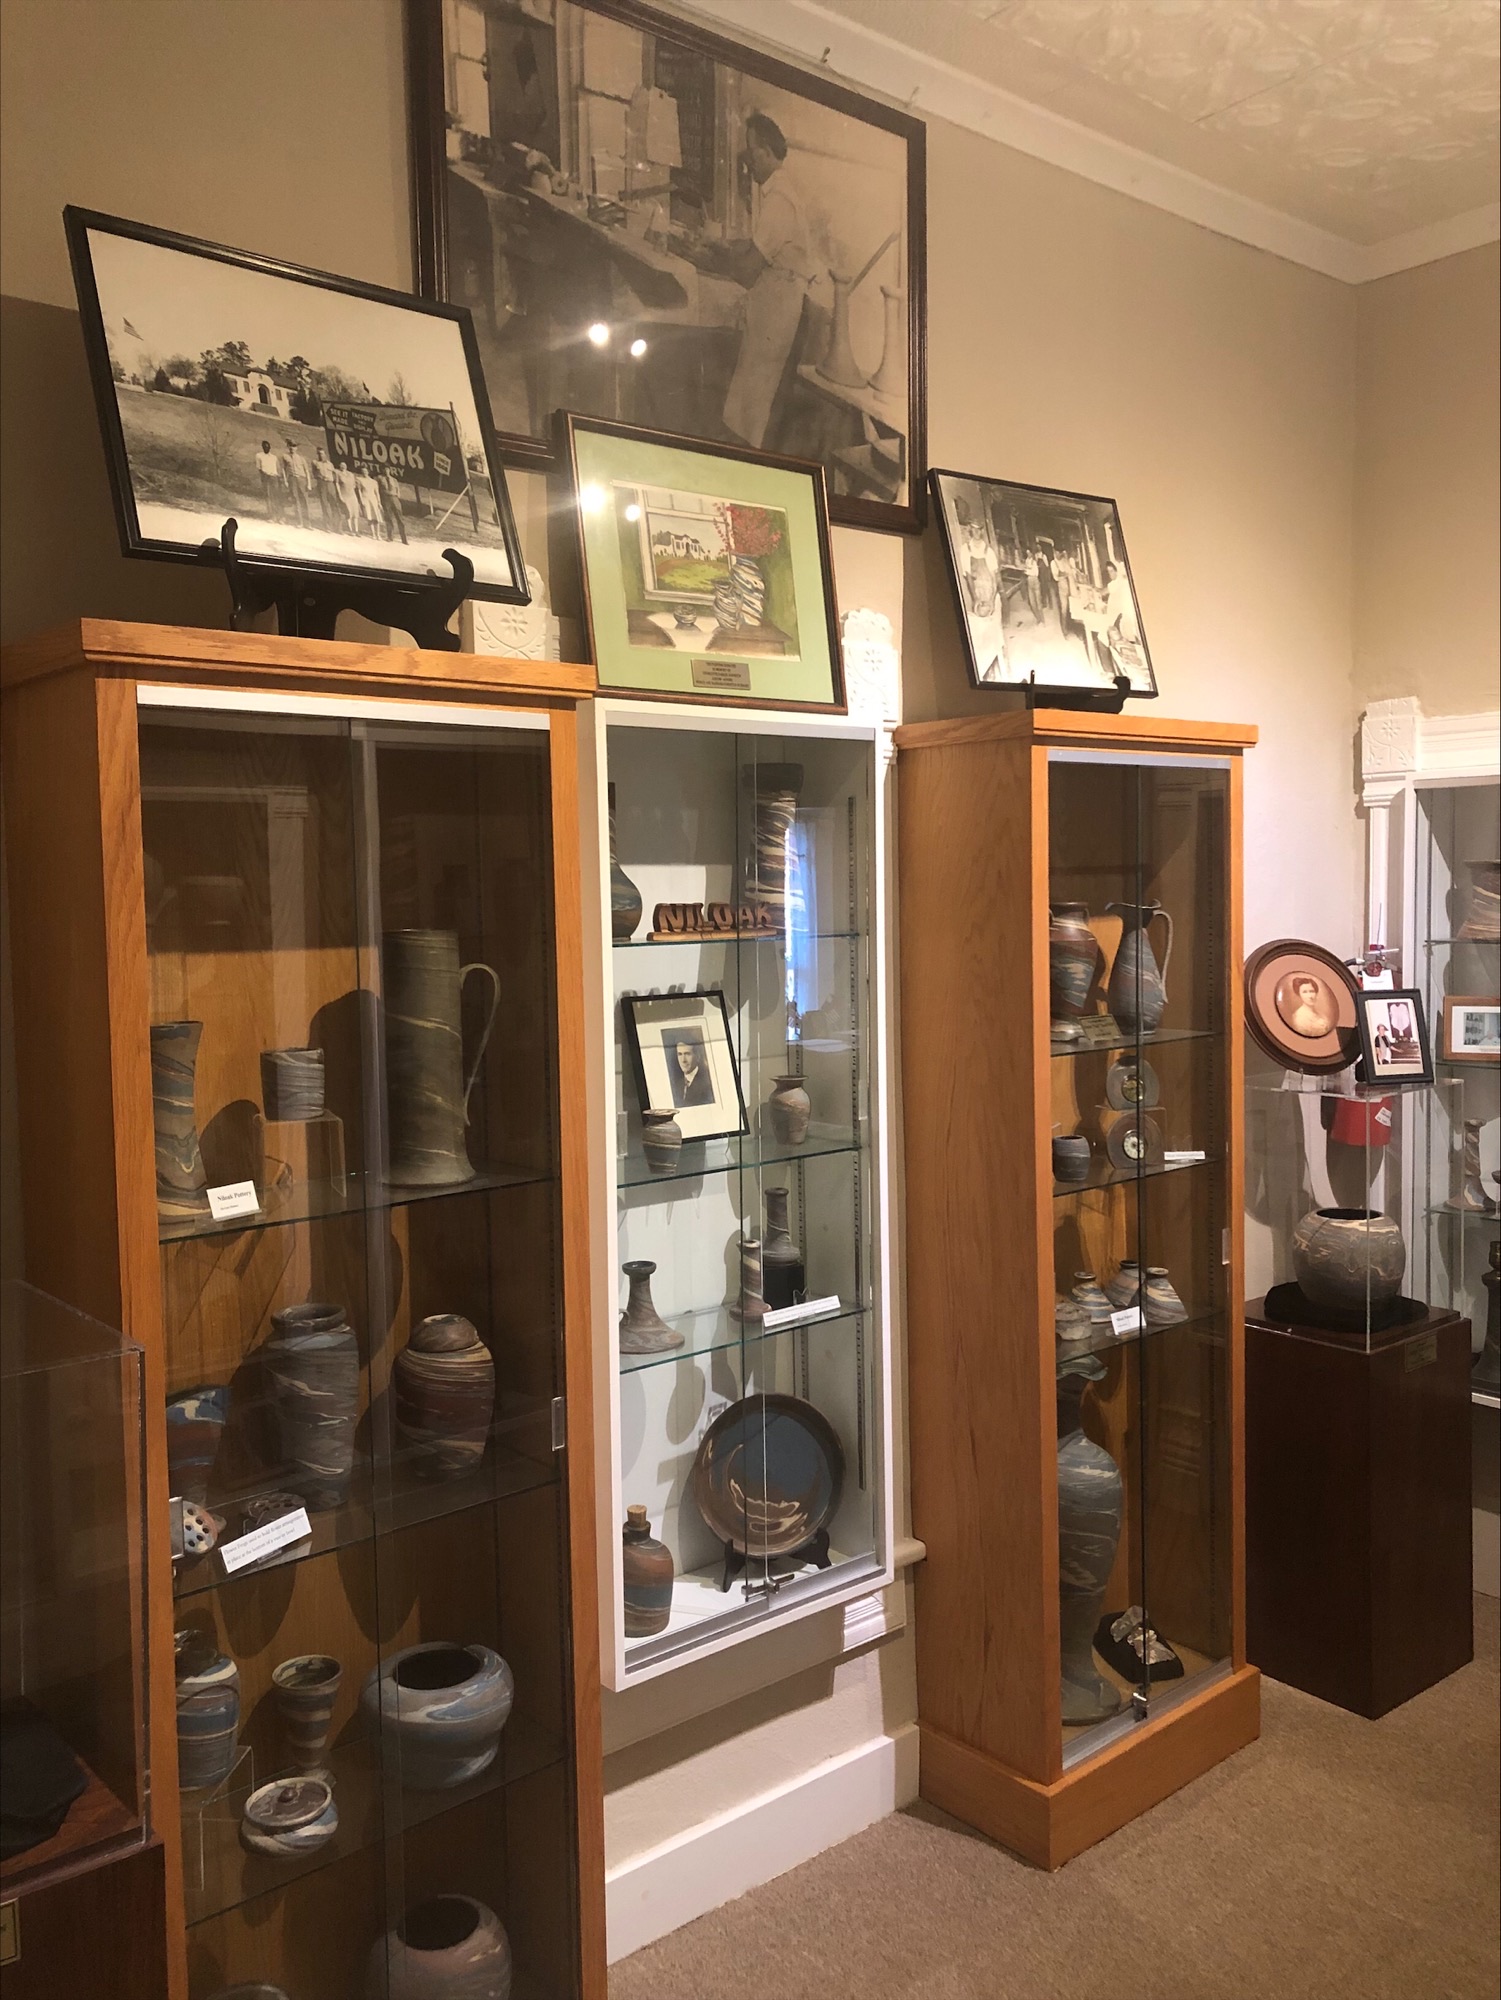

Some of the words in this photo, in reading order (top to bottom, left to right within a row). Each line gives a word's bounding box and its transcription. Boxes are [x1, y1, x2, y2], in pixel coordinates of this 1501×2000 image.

[334, 431, 425, 470] NILOAK
[354, 459, 405, 478] POTTRY
[653, 902, 773, 932] NILOAK
